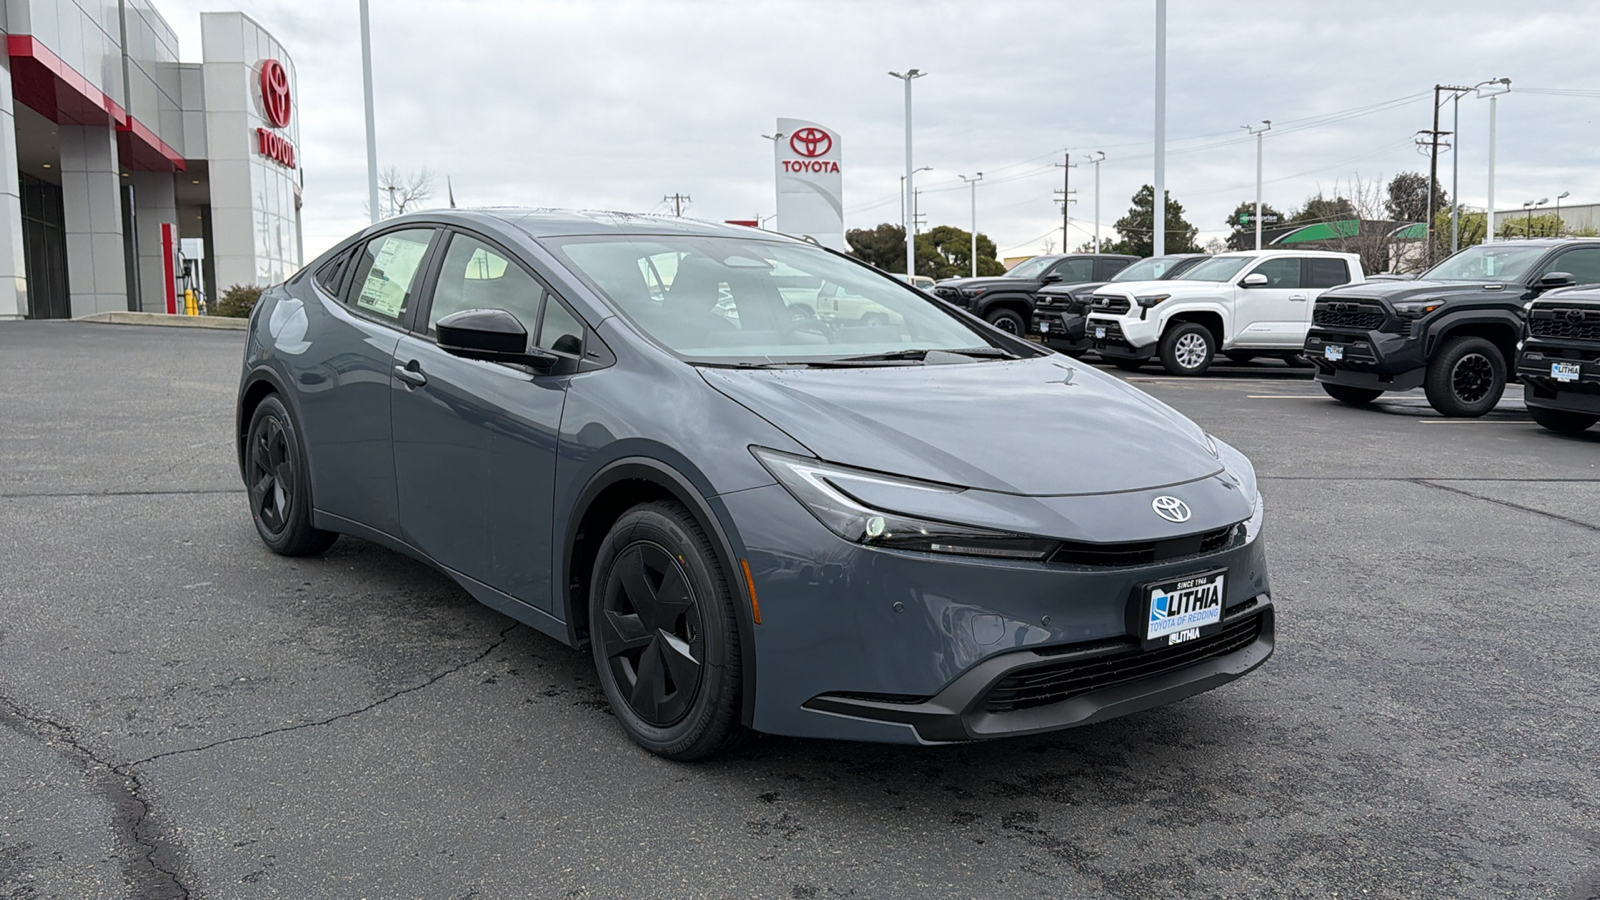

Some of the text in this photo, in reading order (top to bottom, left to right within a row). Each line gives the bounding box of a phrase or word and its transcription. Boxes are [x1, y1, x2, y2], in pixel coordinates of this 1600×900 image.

[782, 160, 840, 173] TOYOTA
[1177, 580, 1194, 590] SINCE
[1167, 585, 1219, 617] LITHIA
[1150, 608, 1219, 632] TOYOTA OF REDDING
[1176, 627, 1200, 643] LITHIA
